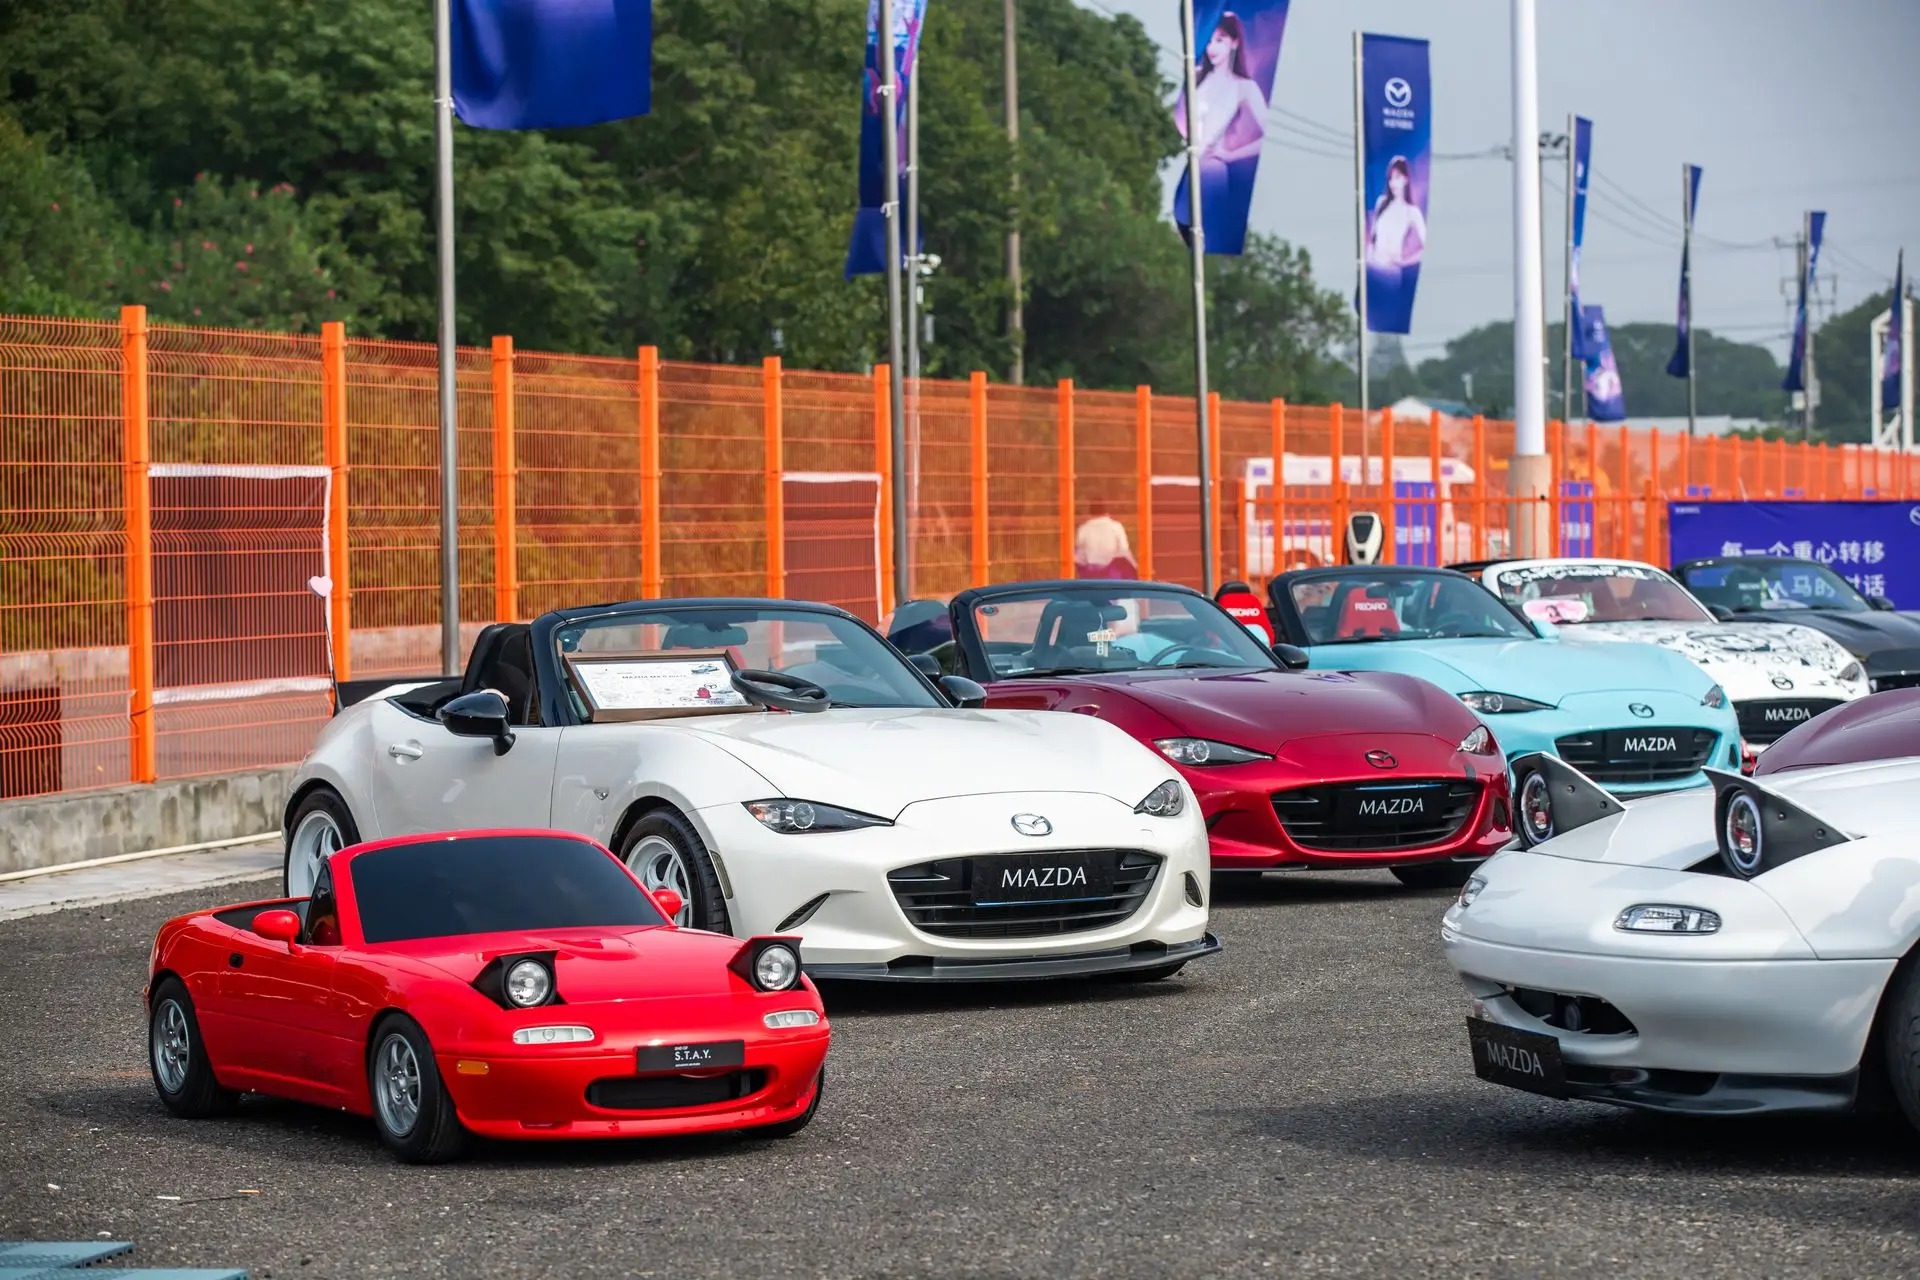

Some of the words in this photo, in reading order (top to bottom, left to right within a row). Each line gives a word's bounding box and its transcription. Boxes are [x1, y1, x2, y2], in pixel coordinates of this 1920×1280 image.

[1765, 707, 1811, 721] MAZDA
[1624, 737, 1677, 752] MAZDA
[1359, 797, 1424, 815] MAZDA
[1001, 866, 1087, 888] MAZDA
[674, 1049, 711, 1061] S.T.A.Y.
[1486, 1040, 1544, 1077] MAZDA
